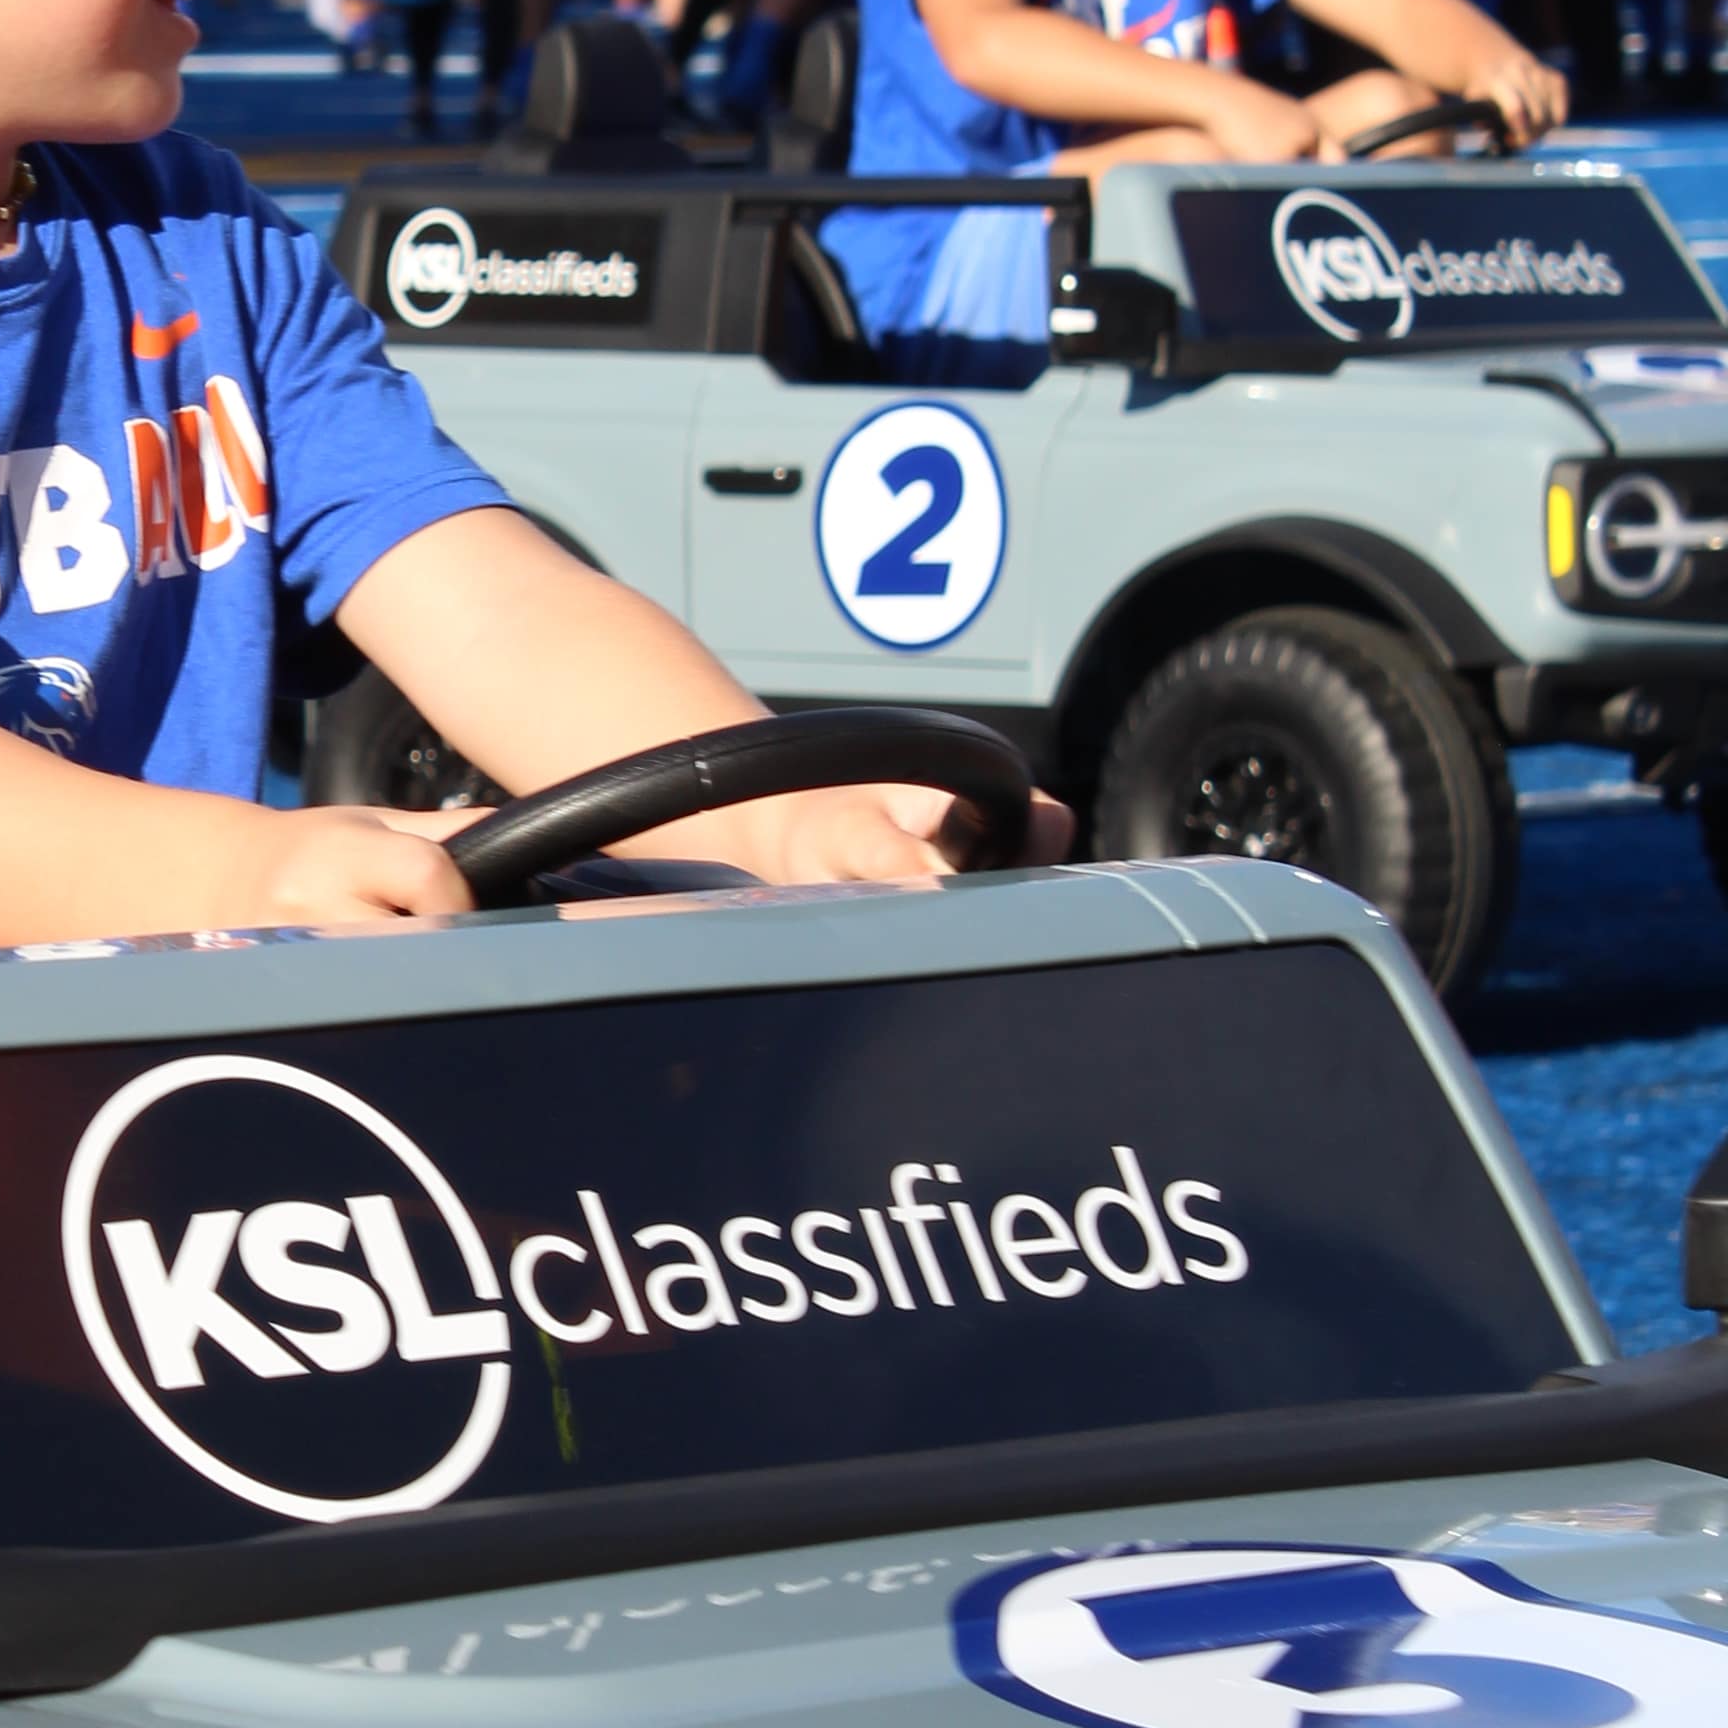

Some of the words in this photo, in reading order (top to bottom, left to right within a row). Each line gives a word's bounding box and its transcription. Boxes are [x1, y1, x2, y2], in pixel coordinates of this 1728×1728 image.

[473, 249, 639, 298] classifieds
[1287, 235, 1412, 303] KSL
[1407, 239, 1625, 297] classifieds
[855, 445, 964, 596] 2
[101, 1194, 511, 1390] KSL
[510, 1144, 1250, 1344] classifieds
